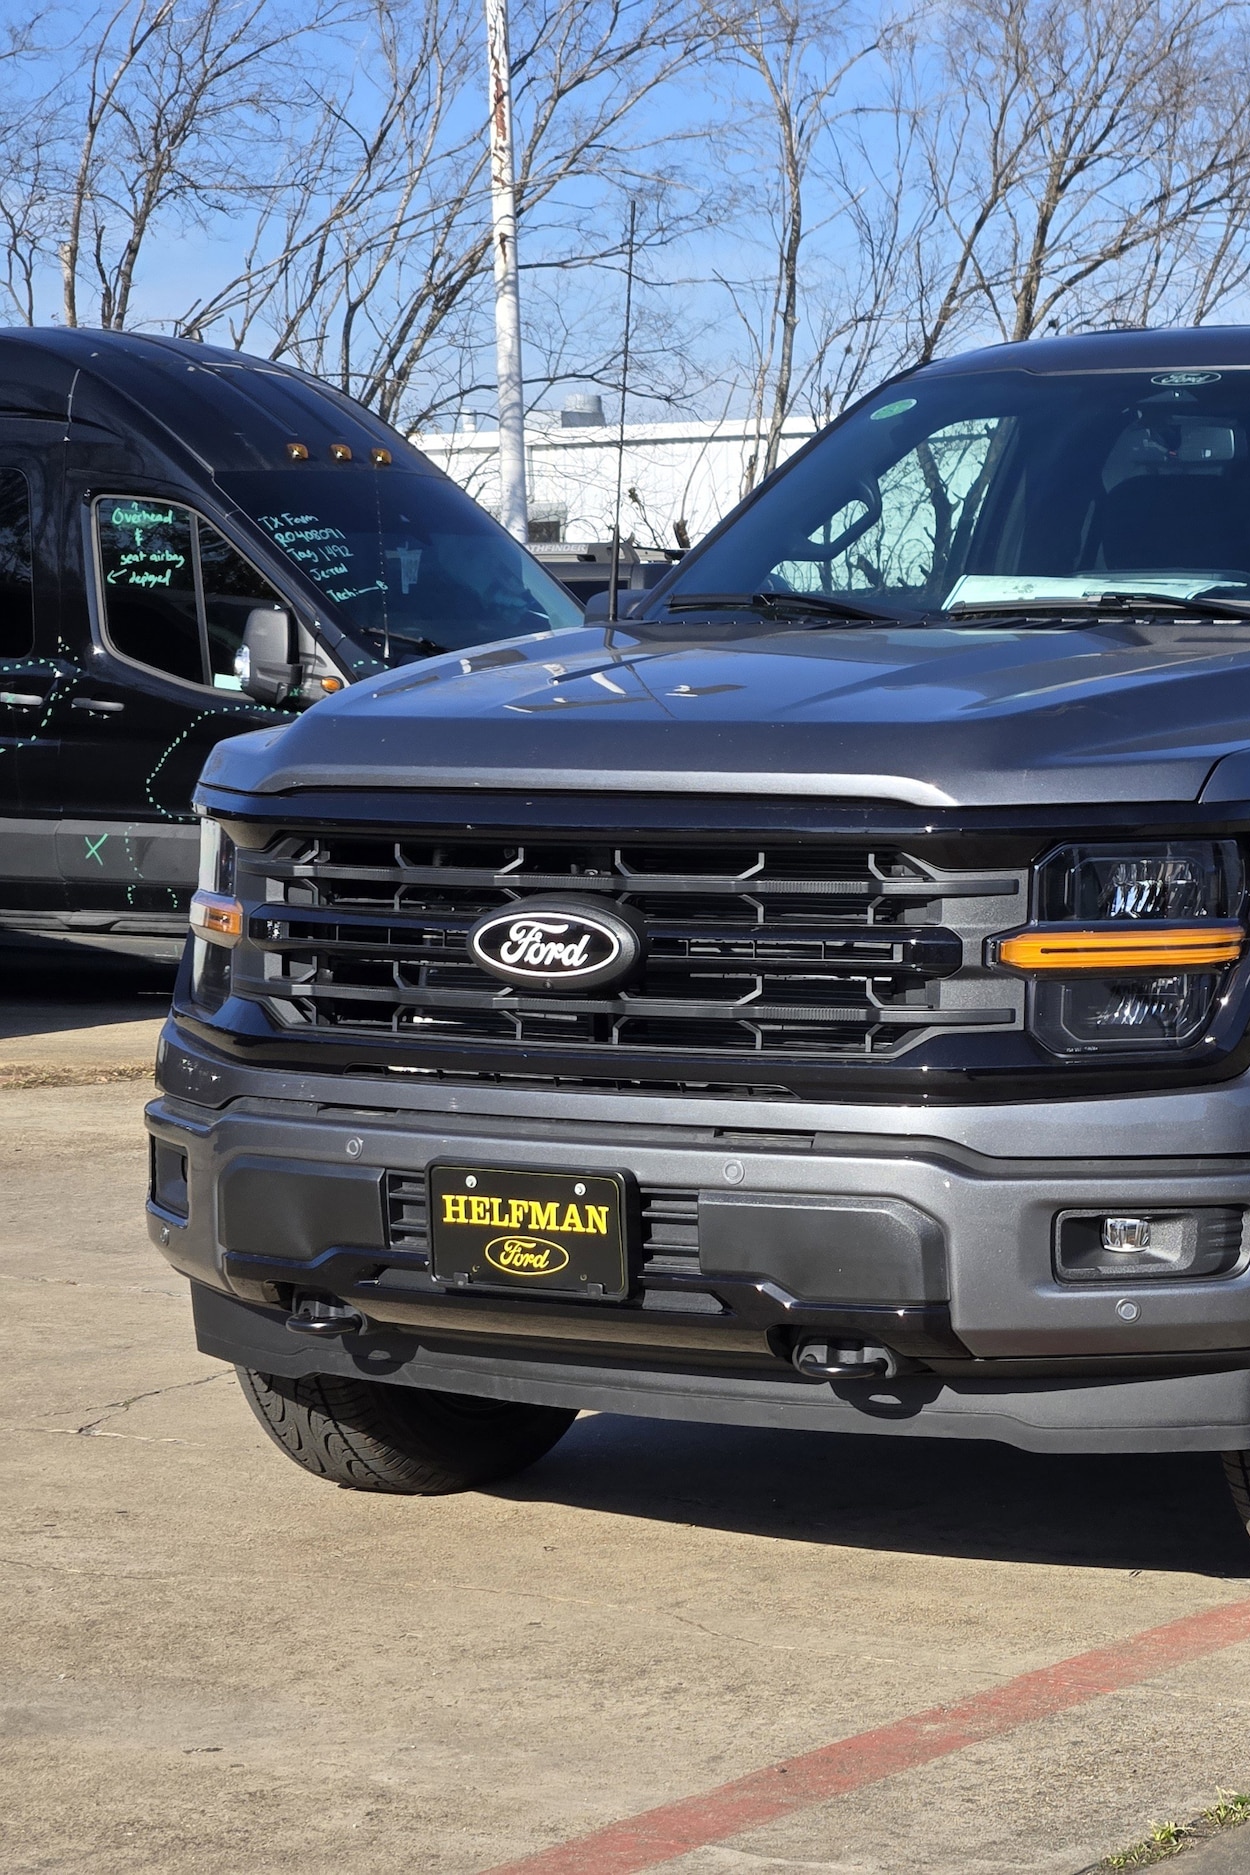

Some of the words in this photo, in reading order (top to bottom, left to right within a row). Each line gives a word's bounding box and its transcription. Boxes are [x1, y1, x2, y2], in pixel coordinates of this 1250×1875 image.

[1161, 373, 1211, 384] Ford
[112, 507, 173, 525] Overhead
[257, 515, 284, 531] TX
[120, 551, 147, 566] seat
[149, 549, 185, 568] airbag
[286, 548, 319, 563] Tag
[318, 545, 354, 561] 1492
[500, 919, 591, 968] Ford
[441, 1194, 610, 1235] HELFMAN
[499, 1239, 551, 1270] Ford
